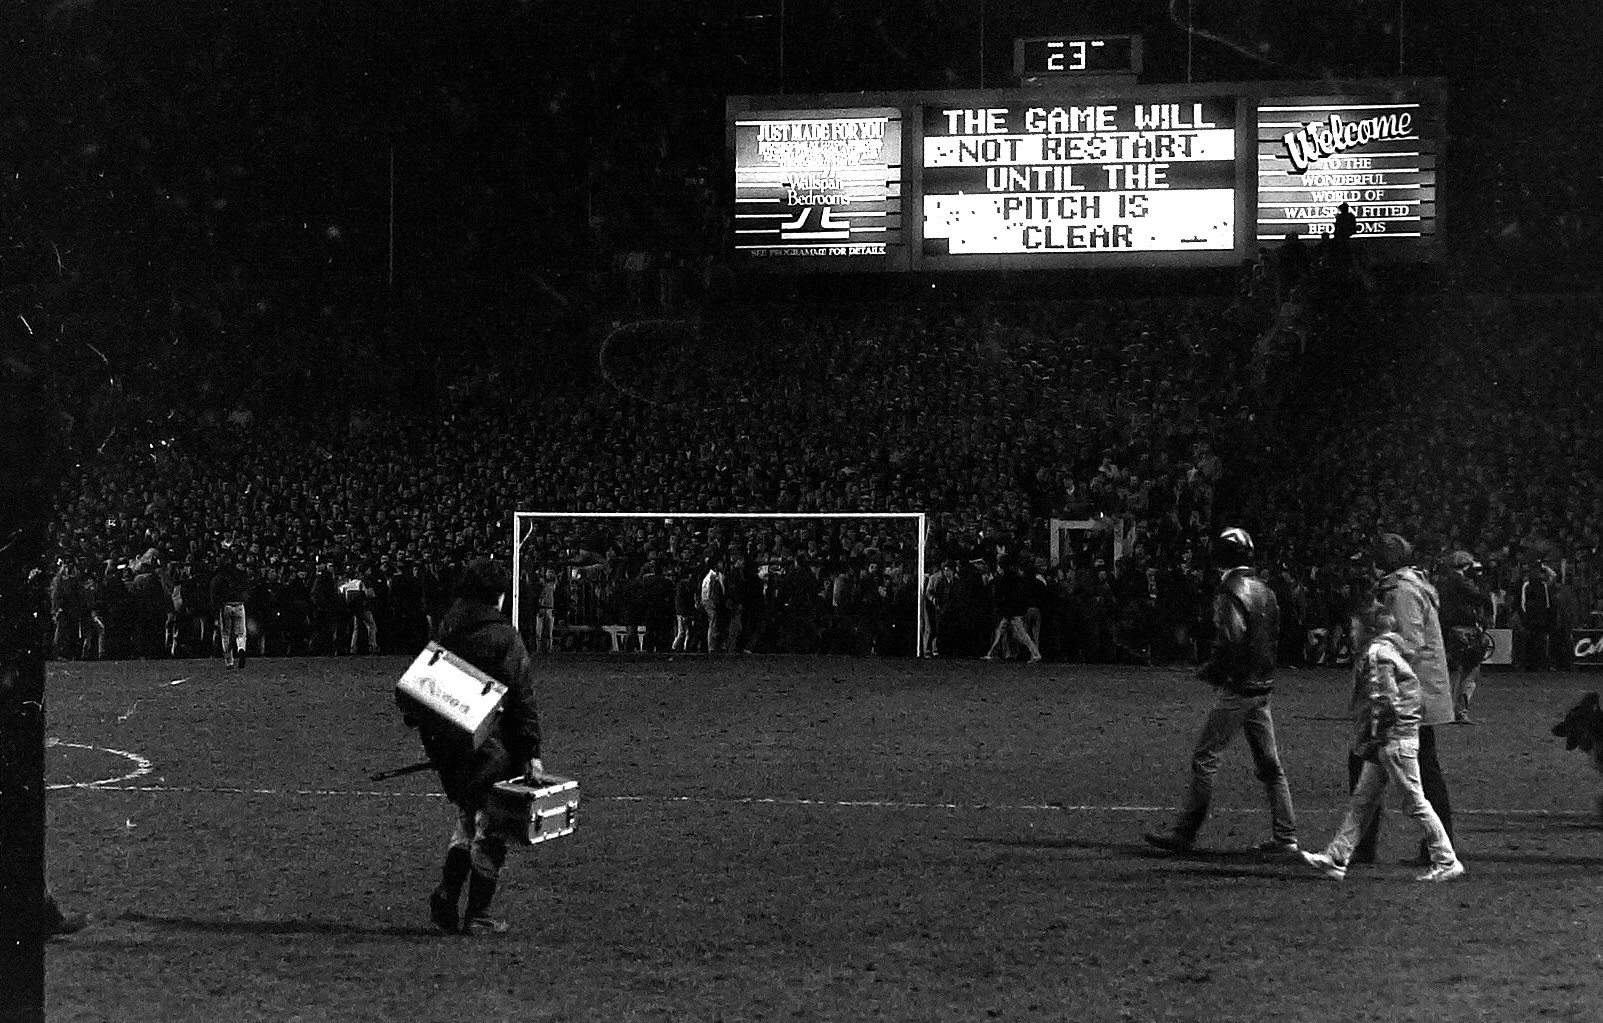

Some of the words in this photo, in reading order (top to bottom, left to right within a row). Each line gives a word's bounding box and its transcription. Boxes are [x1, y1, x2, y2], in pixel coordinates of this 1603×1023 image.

[943, 109, 1009, 134] THE
[1025, 106, 1118, 133] GAME
[1135, 103, 1216, 129] WILL
[757, 124, 791, 142] JUST
[791, 123, 830, 141] MADE
[831, 122, 860, 140] FOR
[860, 121, 885, 139] YOU
[1283, 112, 1413, 171] Welcome
[959, 138, 1023, 162] NOT
[1042, 134, 1199, 160] RESTART
[1323, 158, 1341, 170] TO
[1344, 157, 1372, 169] THE
[787, 173, 844, 193] Wallspan
[986, 166, 1085, 191] UNTIL
[1102, 164, 1170, 189] THE
[1301, 173, 1387, 187] WONDERFUL
[787, 189, 851, 206] Bedrooms
[1311, 189, 1361, 202] WORLD
[1364, 189, 1385, 201] OF
[1003, 195, 1101, 220] PITCH
[1119, 194, 1149, 218] IS
[1284, 206, 1358, 219] WALLSPN
[1362, 204, 1410, 217] FITTED
[1022, 224, 1133, 249] CLEAR
[1308, 221, 1387, 235] BEDOMS
[828, 247, 848, 256] FOR
